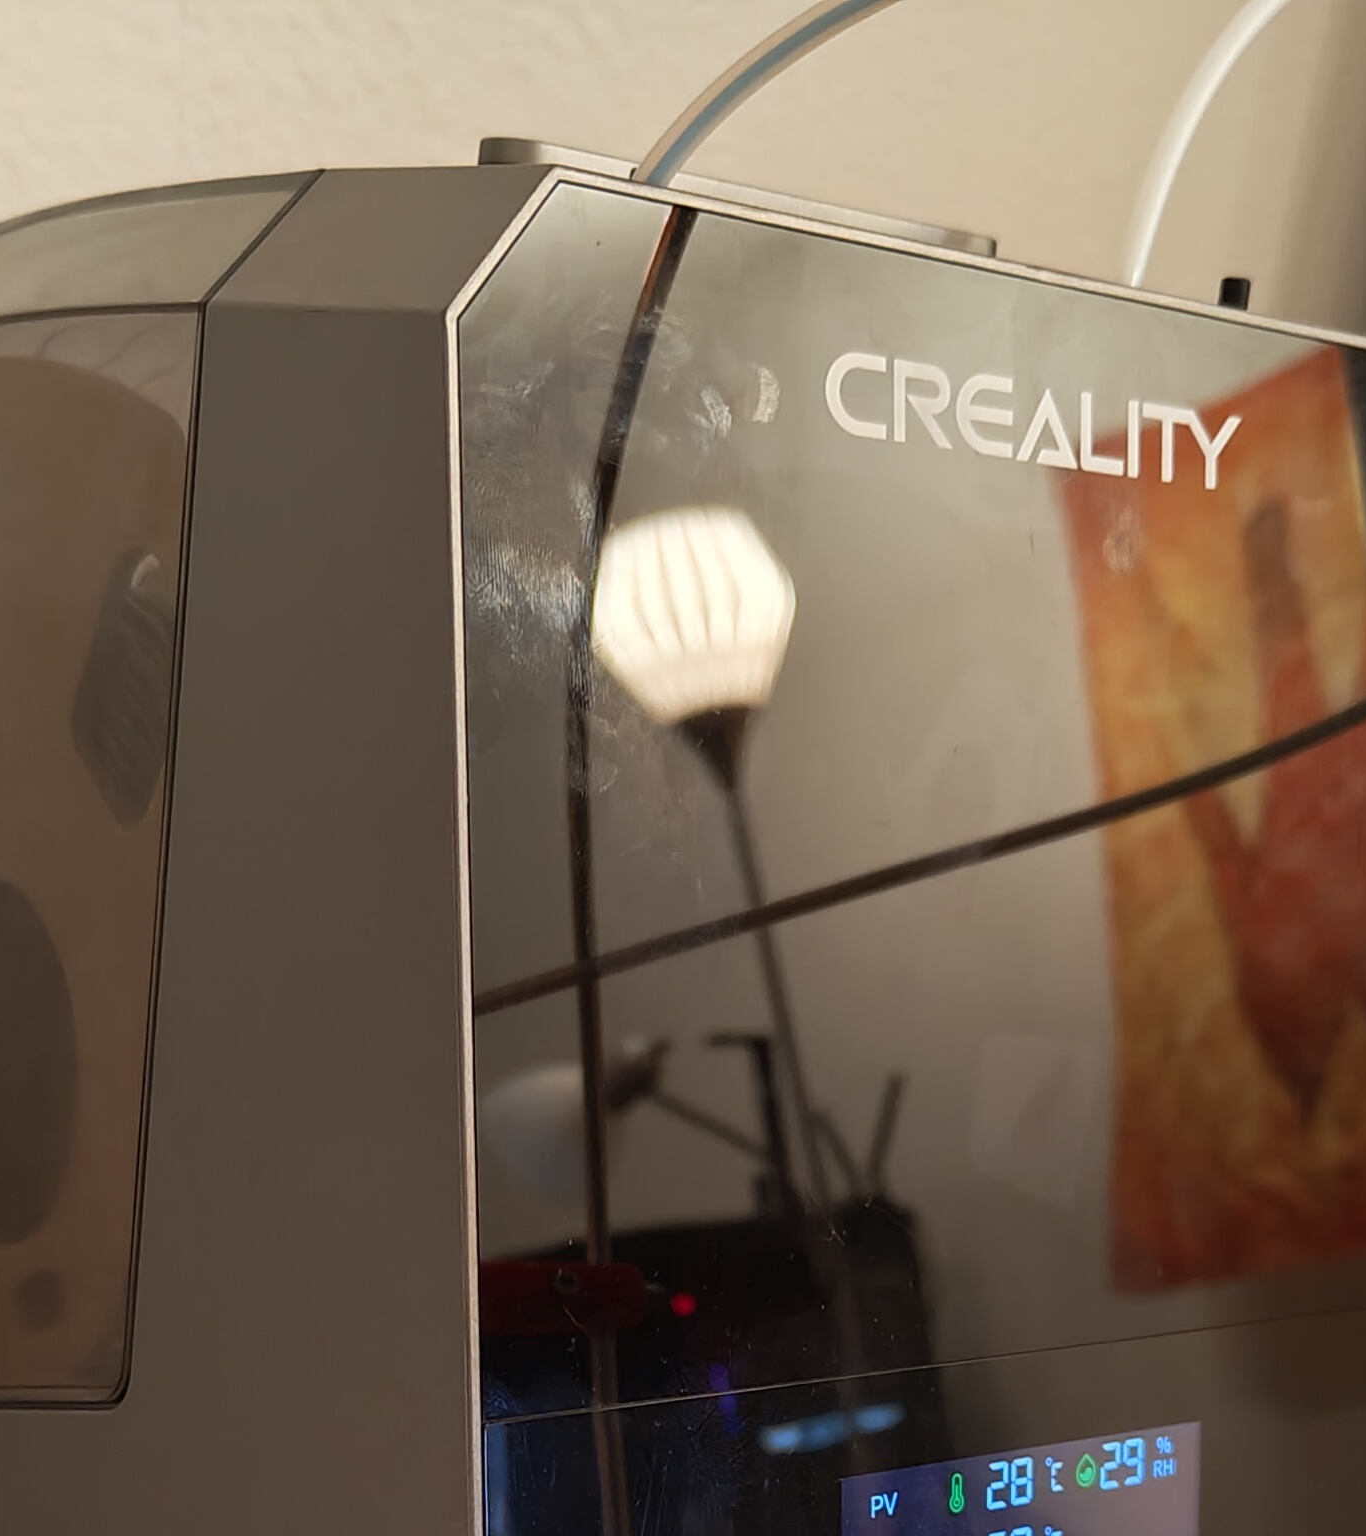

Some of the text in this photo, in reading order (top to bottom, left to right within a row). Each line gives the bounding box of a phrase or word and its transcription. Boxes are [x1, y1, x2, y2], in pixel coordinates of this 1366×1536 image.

[824, 351, 1243, 490] CREALITY
[870, 1491, 898, 1519] PV
[986, 1456, 1034, 1511] 28
[1099, 1437, 1145, 1490] 29
[1153, 1458, 1176, 1478] RH
